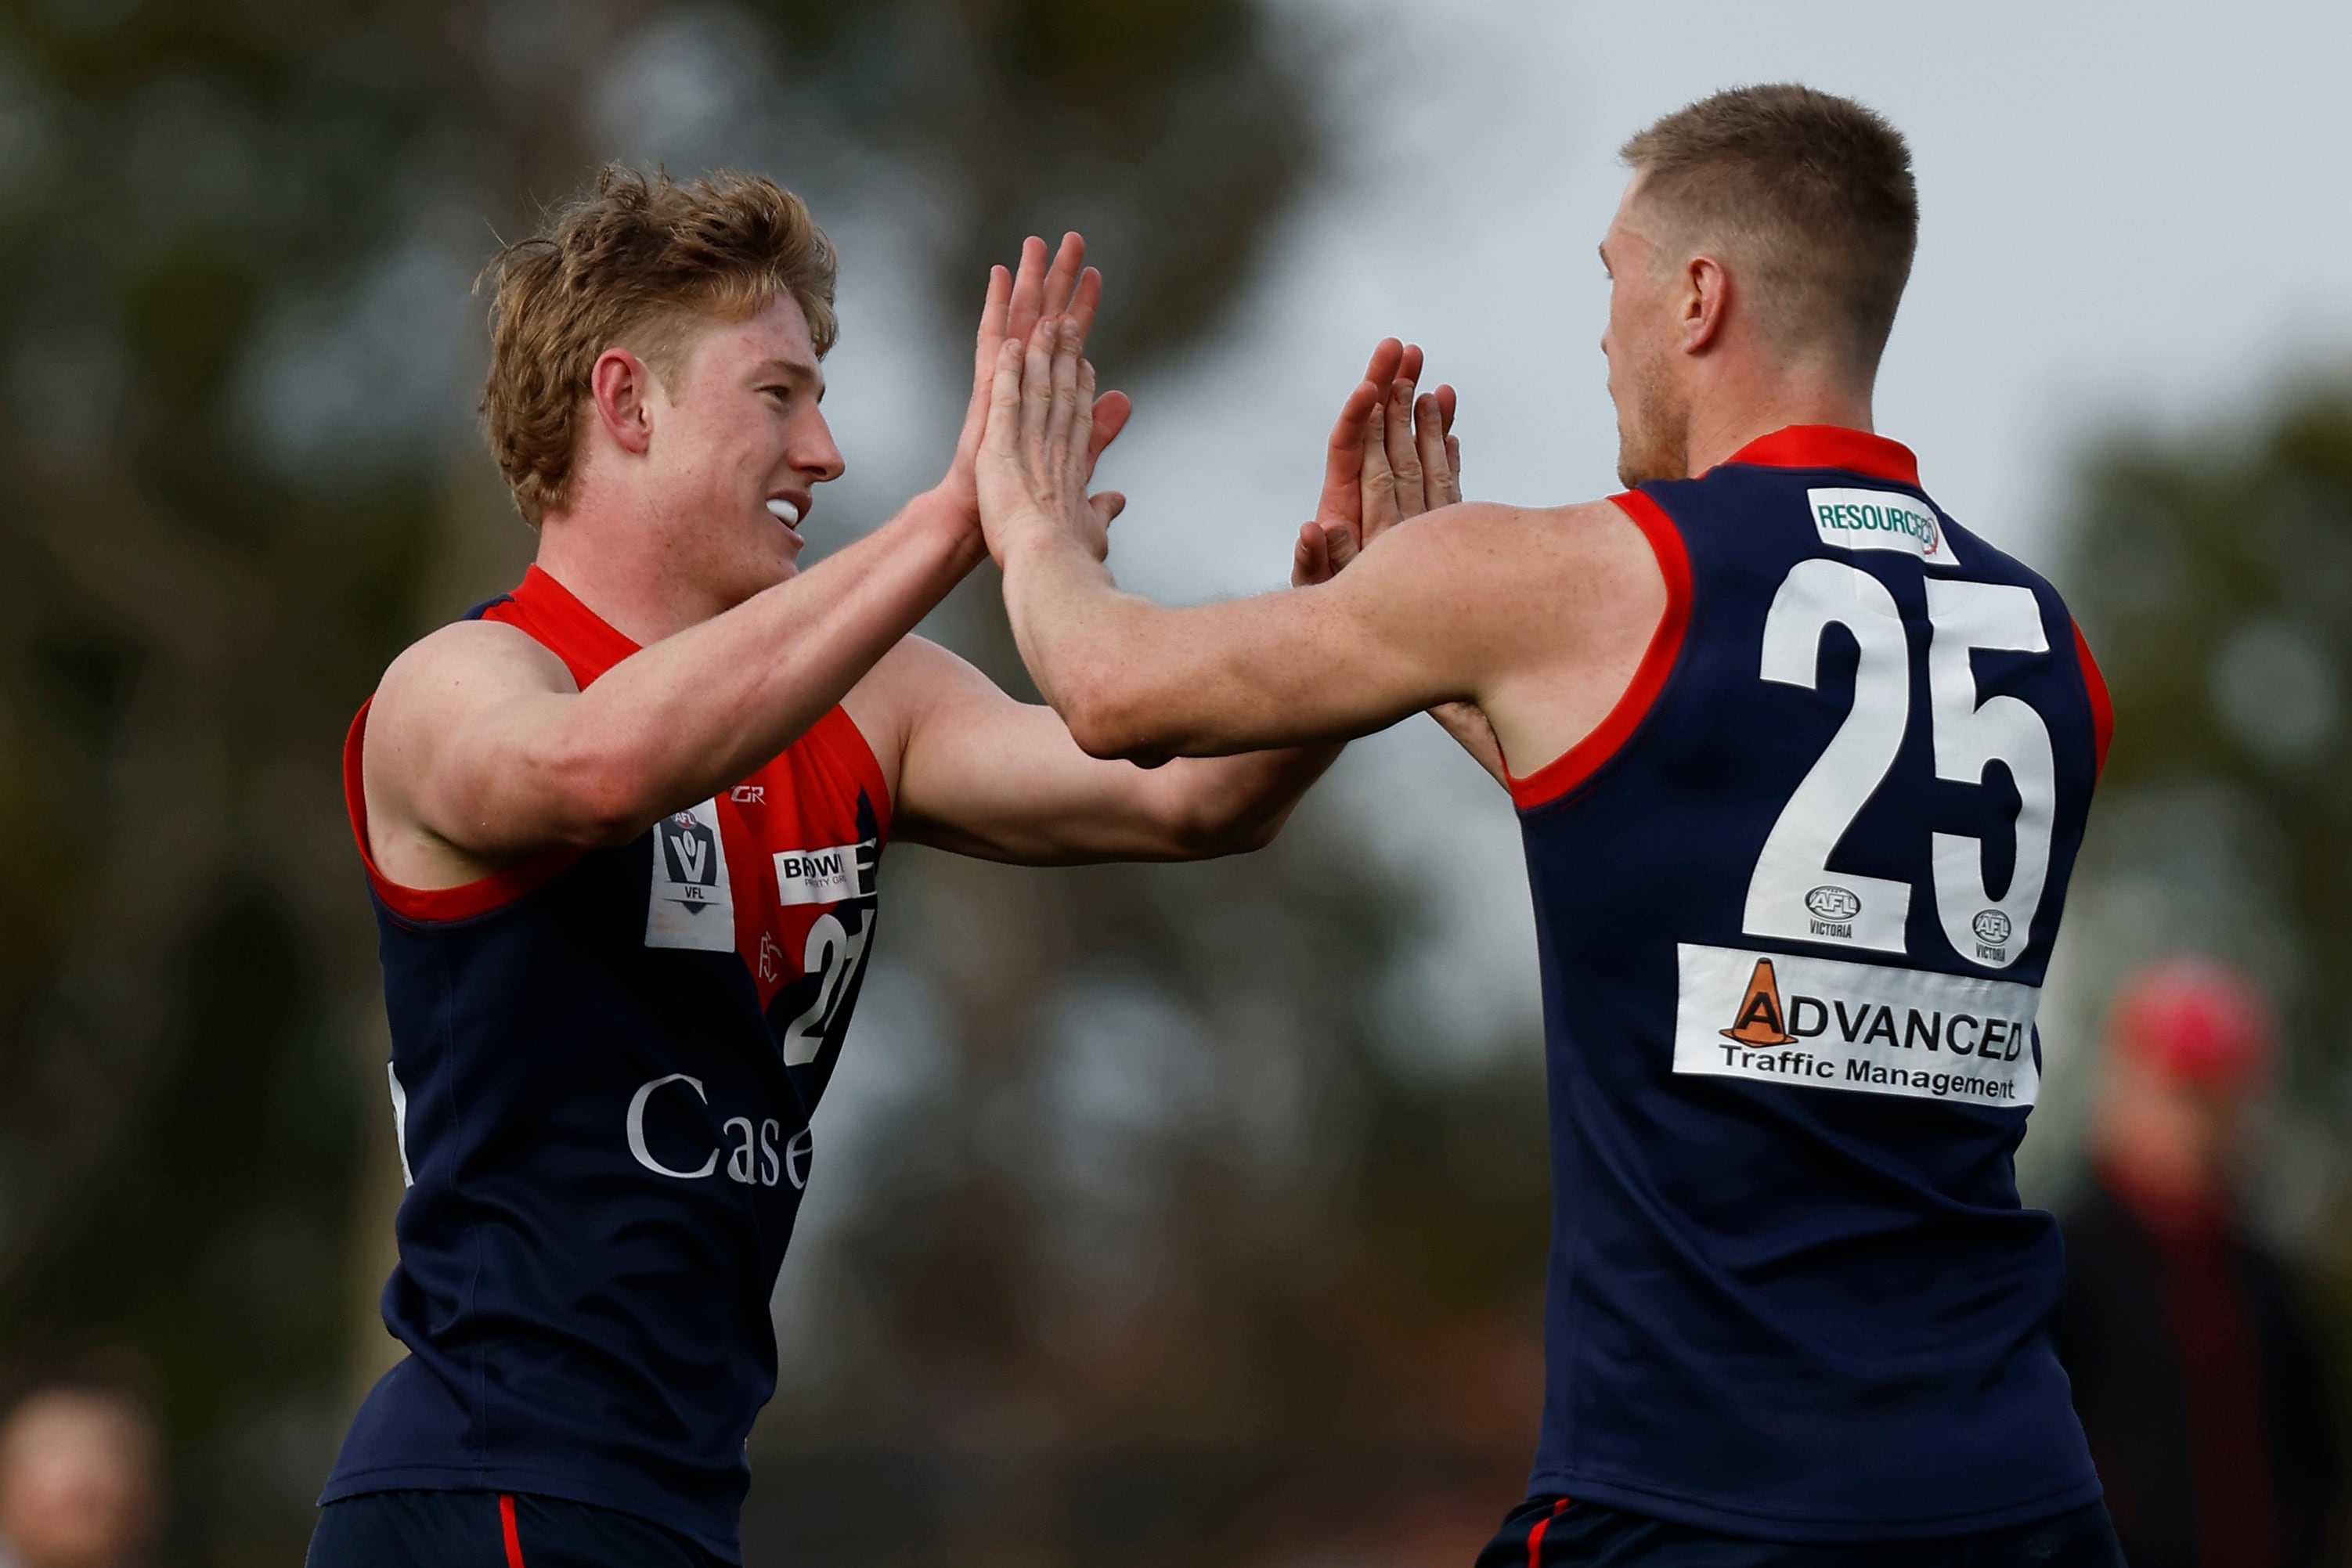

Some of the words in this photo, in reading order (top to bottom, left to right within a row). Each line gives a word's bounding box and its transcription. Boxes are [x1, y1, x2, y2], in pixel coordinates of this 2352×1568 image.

[1741, 557, 2056, 970] 25
[674, 813, 695, 826] AFL
[685, 885, 705, 899] VFL
[1809, 892, 1857, 915] AFL
[1809, 917, 1852, 939] VICTORIA
[1975, 915, 2009, 937] AFL
[1975, 943, 2006, 962] VICTORIA
[1736, 991, 2022, 1062] ADVANCED
[1719, 1044, 1834, 1079] Traffic
[1846, 1058, 2015, 1100] Management
